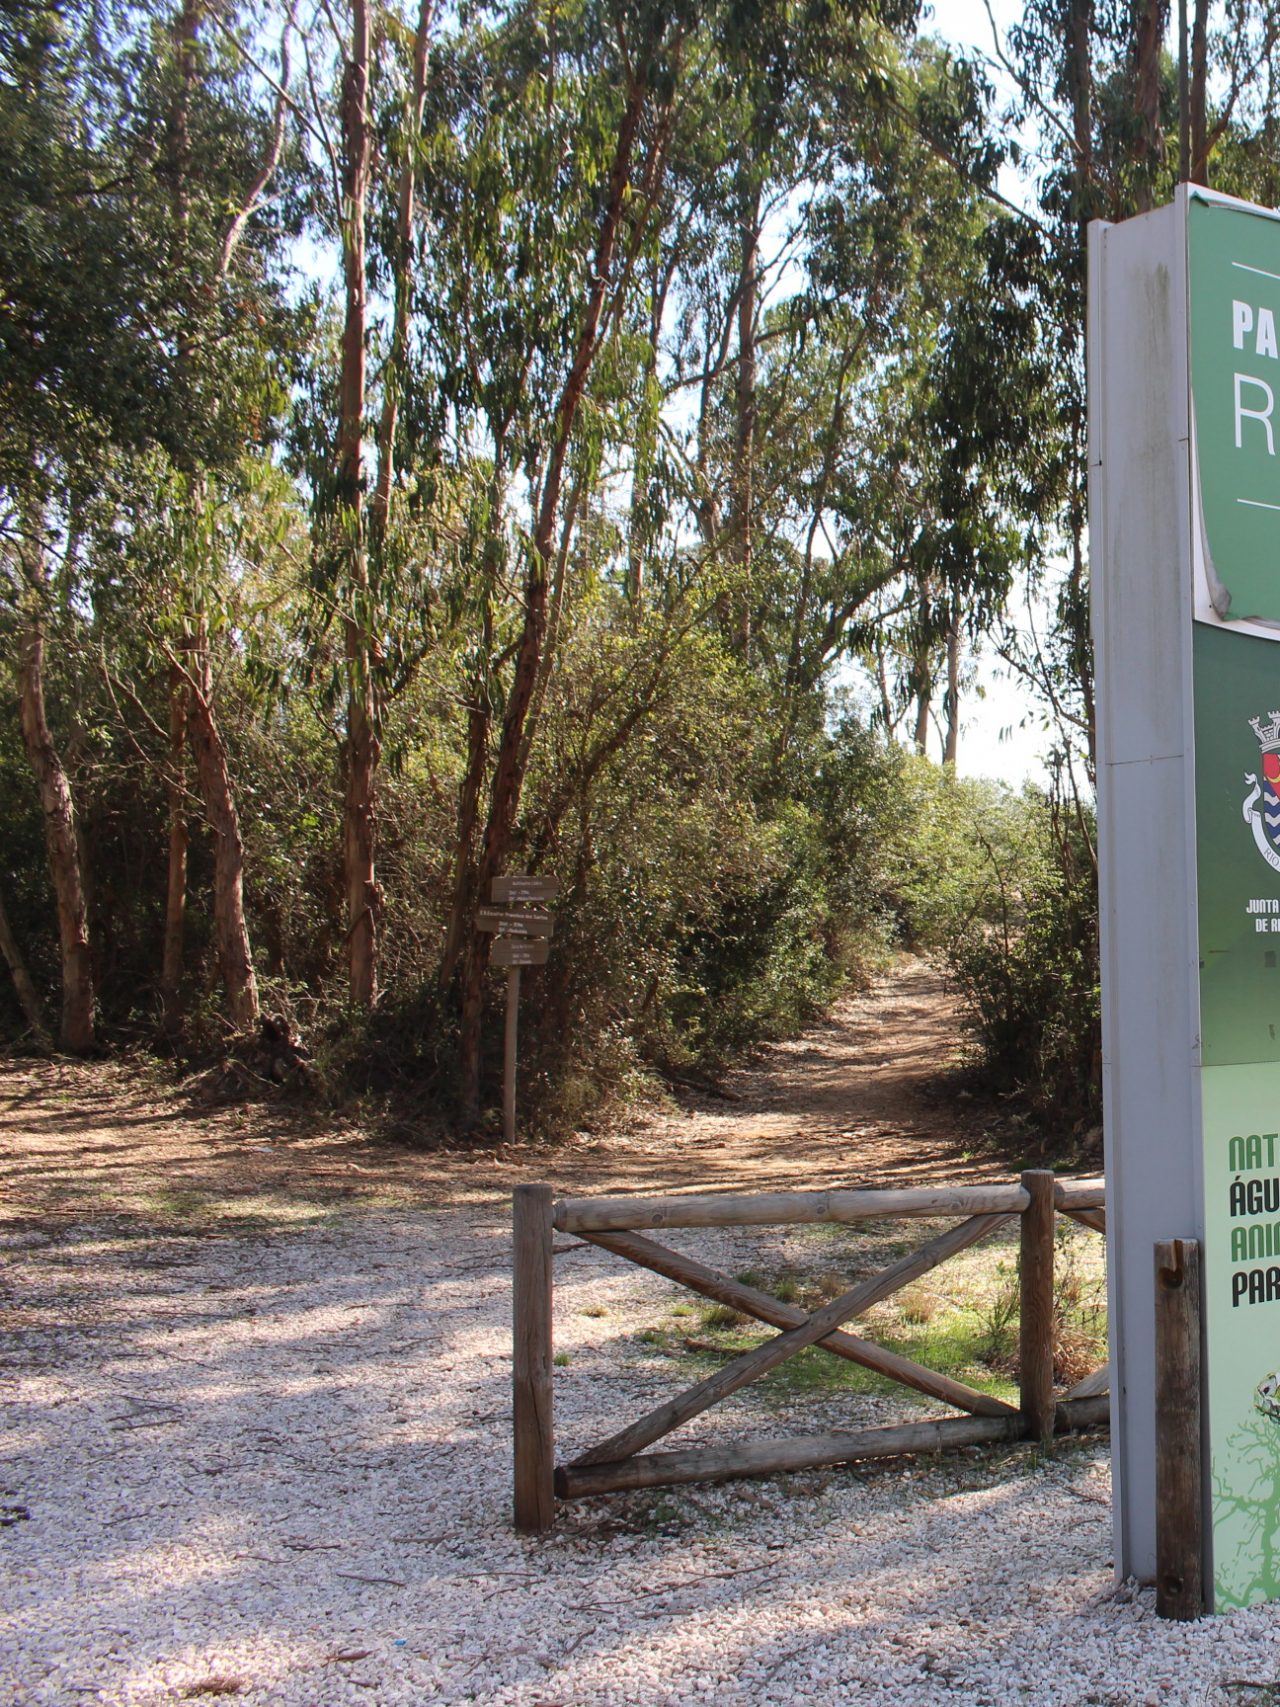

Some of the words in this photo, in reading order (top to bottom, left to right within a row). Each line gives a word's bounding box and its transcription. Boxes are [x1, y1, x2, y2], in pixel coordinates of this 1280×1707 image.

[1264, 847, 1279, 867] RIO
[1246, 899, 1279, 914] JUNTA
[1255, 918, 1269, 933] DE
